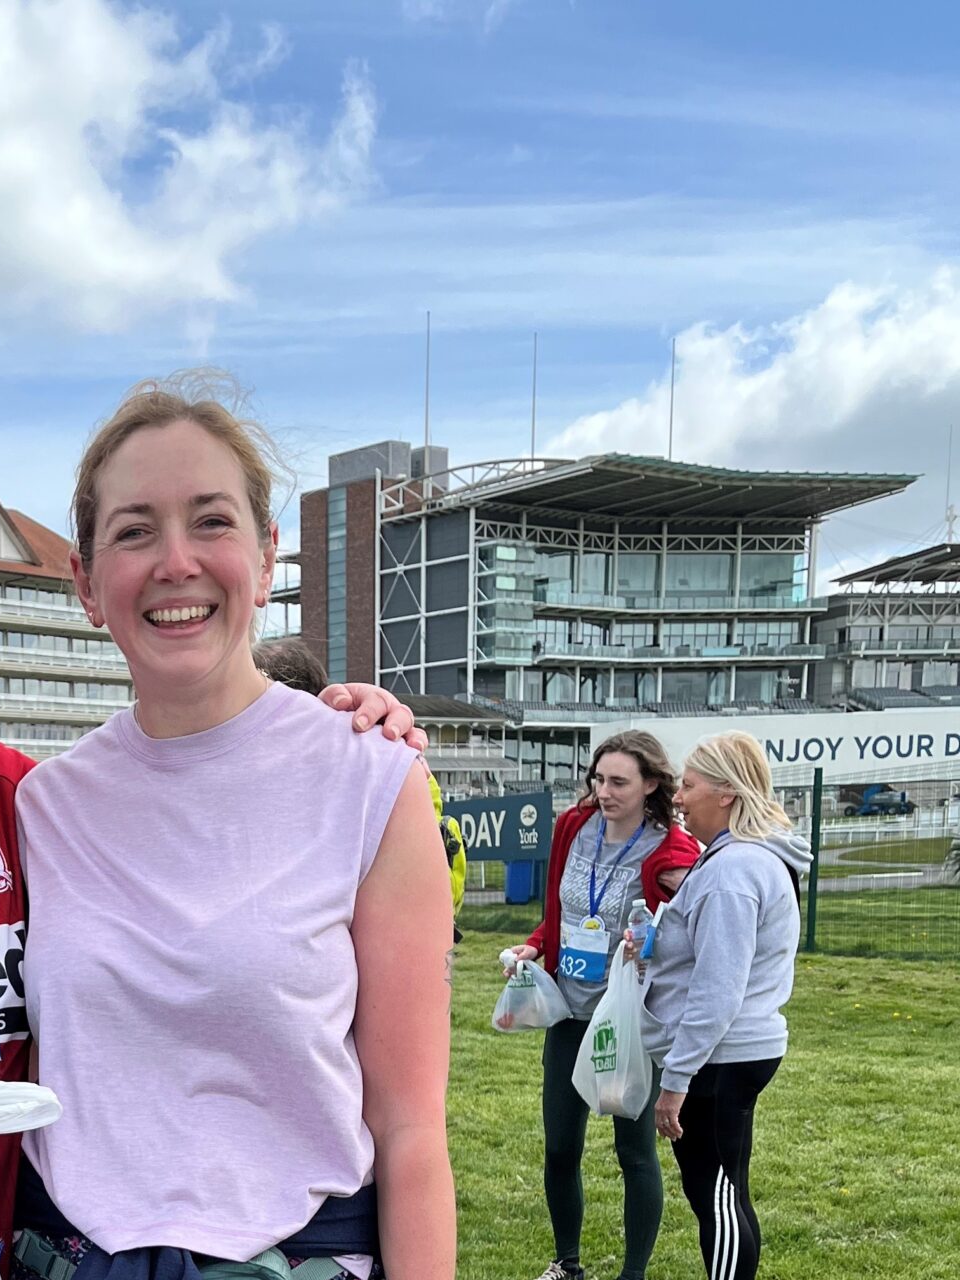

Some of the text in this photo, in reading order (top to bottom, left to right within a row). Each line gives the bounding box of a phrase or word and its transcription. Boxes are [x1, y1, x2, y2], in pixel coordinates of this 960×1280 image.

[764, 737, 843, 762] NJOY
[854, 734, 934, 759] YOUR
[518, 828, 538, 845] York
[560, 954, 587, 978] 432
